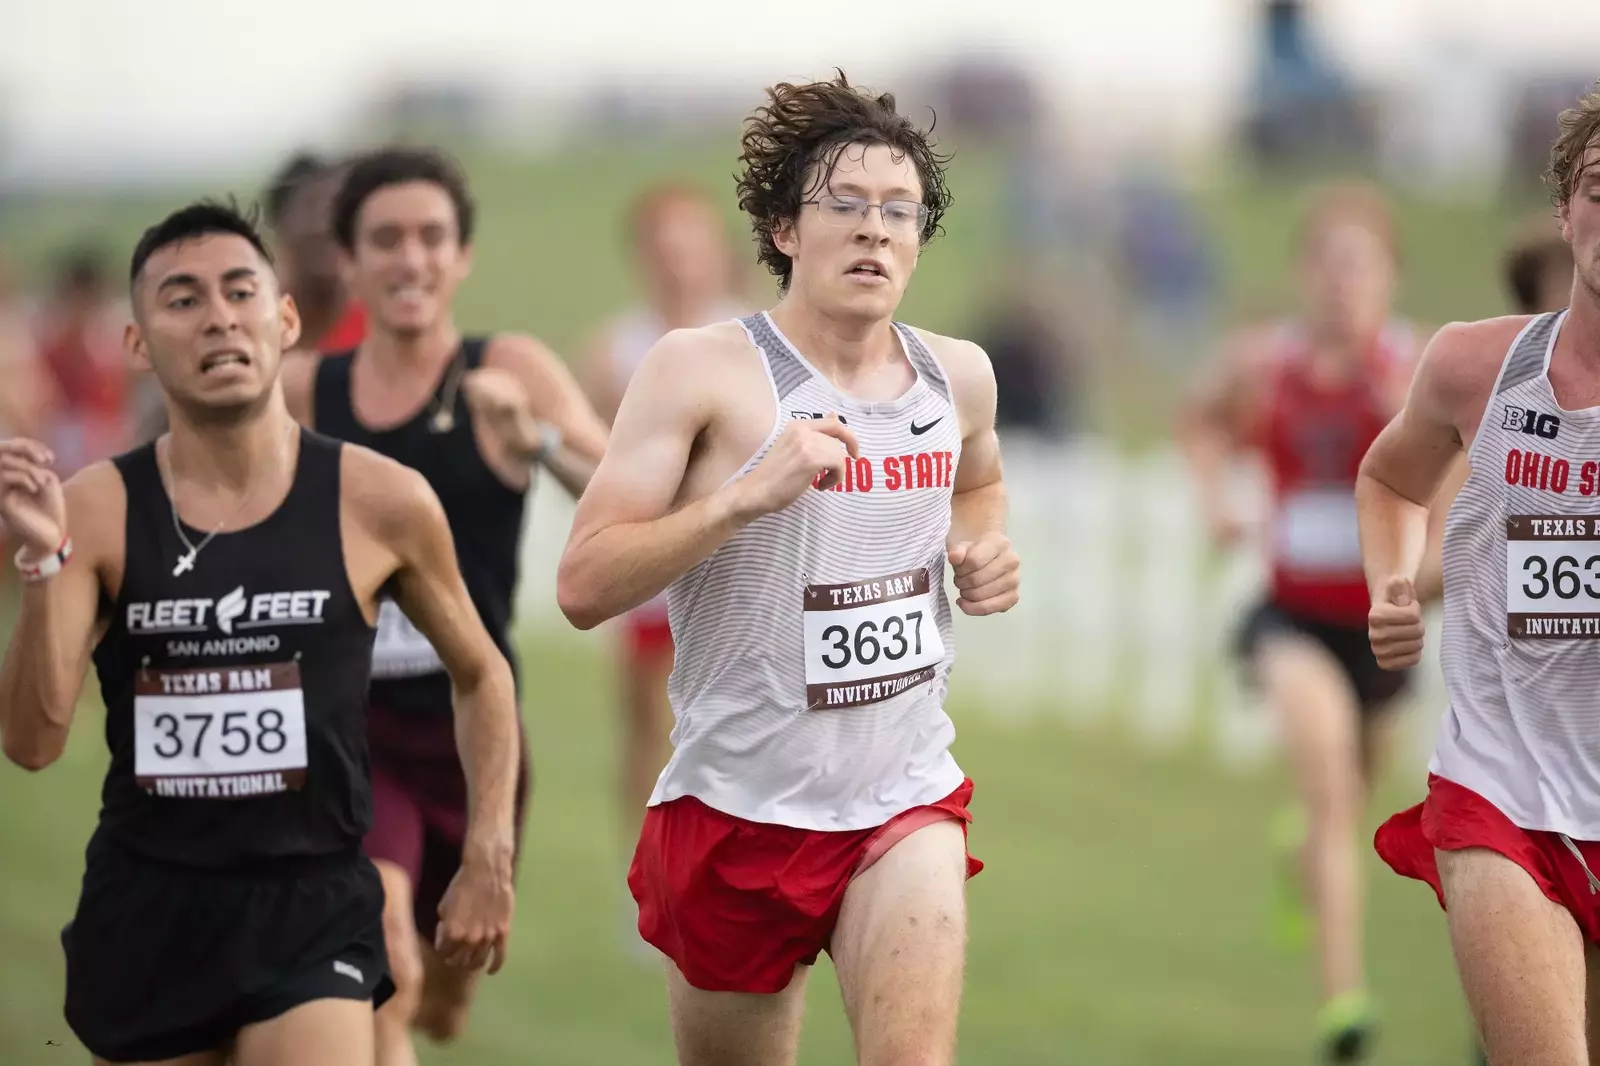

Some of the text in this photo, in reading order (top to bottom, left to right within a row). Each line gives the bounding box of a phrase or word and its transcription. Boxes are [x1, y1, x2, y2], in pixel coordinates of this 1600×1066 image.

[883, 451, 952, 492] STATE
[1505, 448, 1570, 493] OHIO
[1531, 519, 1586, 536] TEXAS
[829, 575, 914, 606] TEXAS A&M
[127, 590, 331, 628] FLEET FEET
[167, 635, 279, 656] SAN ANTONIO
[821, 610, 923, 669] 3637
[160, 669, 272, 693] TEXAS A&M
[153, 708, 287, 758] 3758
[156, 772, 287, 797] INVITATIONAL
